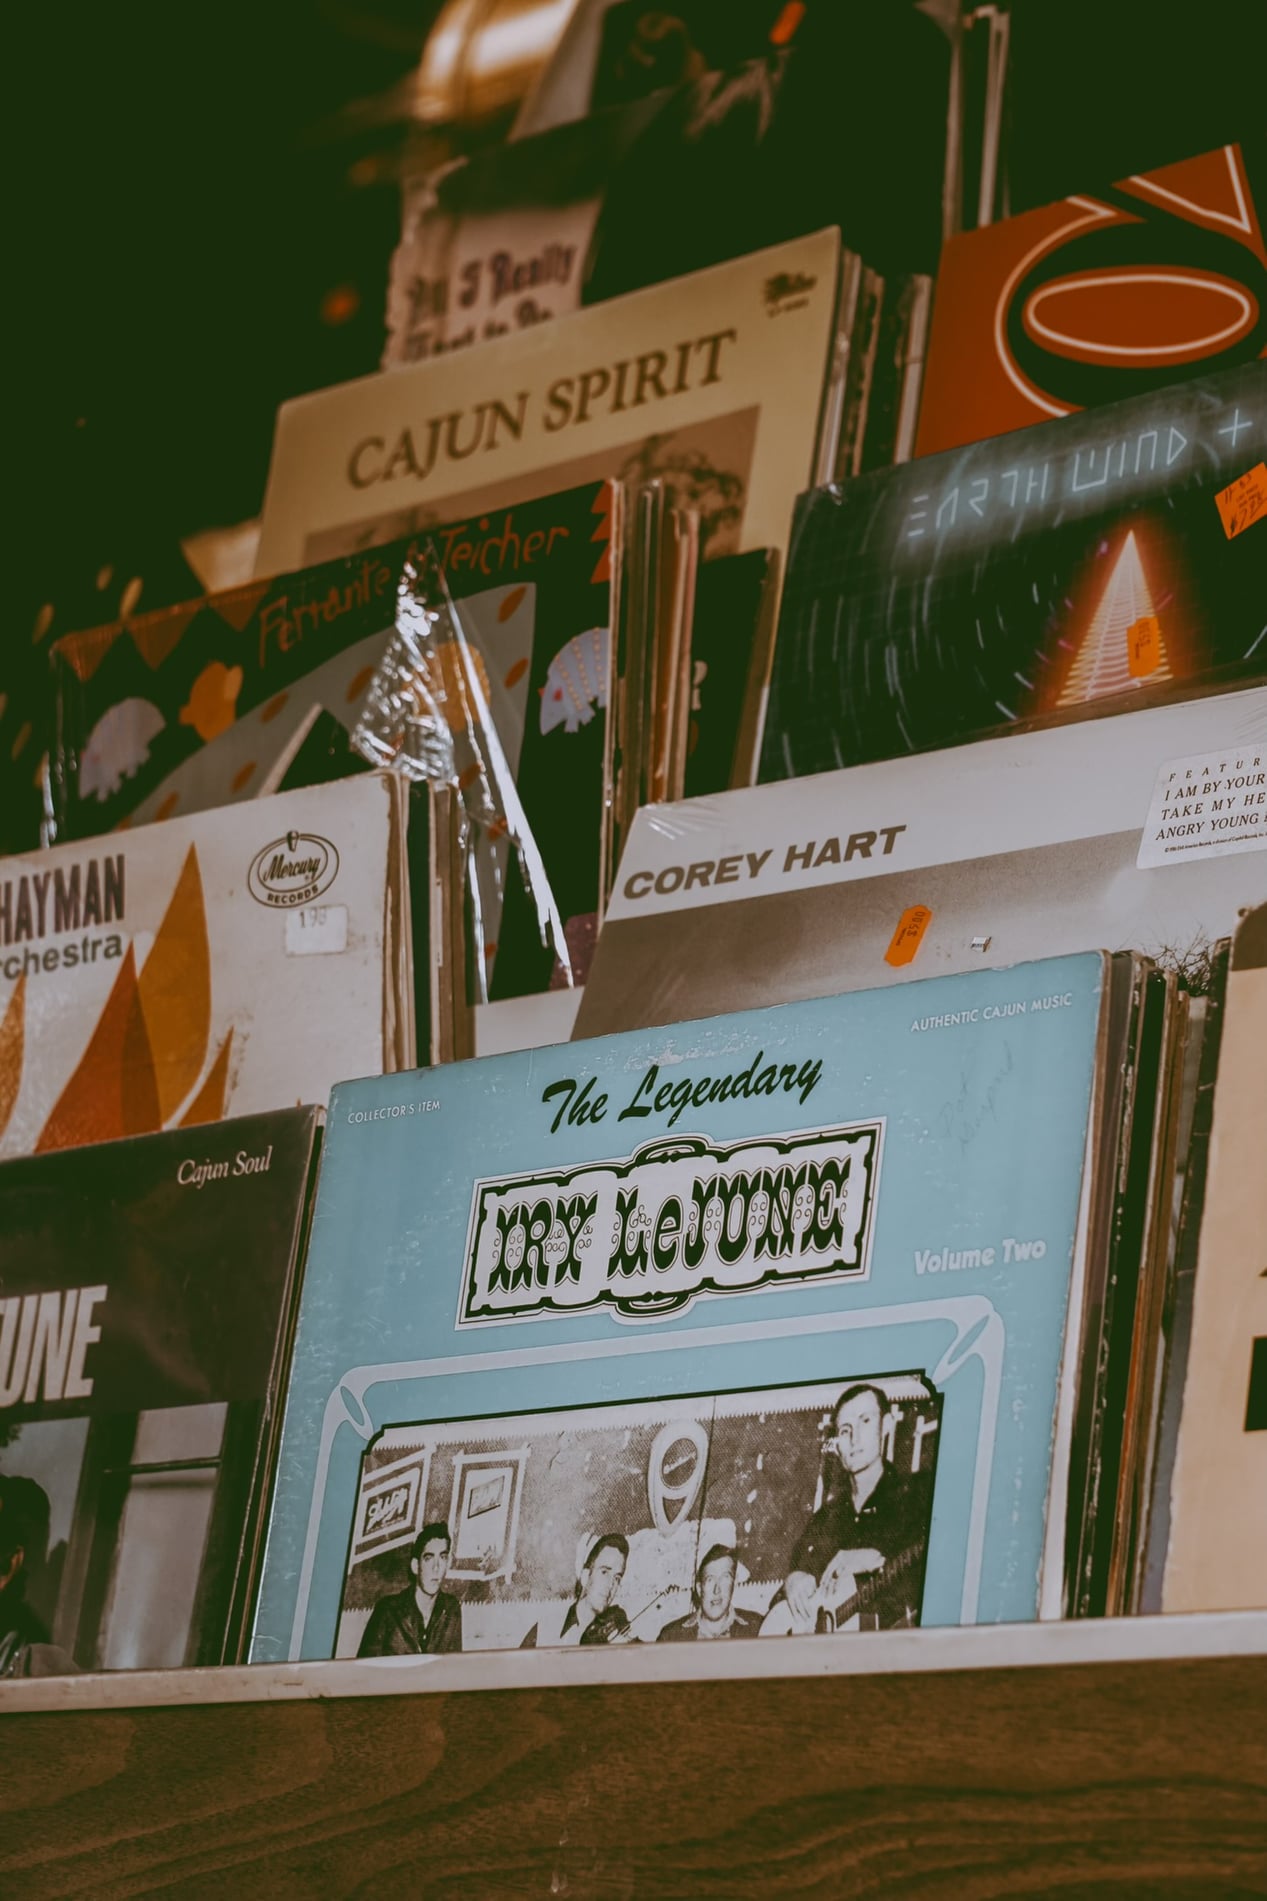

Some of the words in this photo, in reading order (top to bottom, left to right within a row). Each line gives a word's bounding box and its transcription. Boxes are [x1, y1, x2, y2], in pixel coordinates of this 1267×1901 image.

[347, 391, 530, 490] CAJUN
[542, 328, 738, 434] SPIRIT
[908, 462, 1049, 537] EARTH
[1072, 426, 1188, 493] WIND
[258, 560, 391, 669] Ferrante
[437, 513, 571, 576] Teicher
[1164, 789, 1171, 802] I
[1174, 785, 1198, 800] AM
[1202, 780, 1222, 795] BY
[1225, 773, 1266, 791] YOUR
[1168, 757, 1261, 782] FEATUR
[1155, 821, 1205, 841] ANGRY
[1211, 812, 1260, 832] YOUNG
[1161, 802, 1204, 821] TAKE
[1211, 797, 1236, 812] MY
[262, 853, 321, 882] Mercury
[623, 848, 774, 900] COREY
[782, 824, 908, 873] HART
[0, 853, 125, 947] HAYMAN
[267, 884, 319, 904] RECORDS
[0, 933, 123, 980] chestra
[910, 1008, 979, 1033] AUTHENTIC
[983, 1001, 1027, 1021] CAJUN
[1031, 992, 1073, 1012] MUSIC
[347, 1103, 415, 1124] COLLECTOR'S
[418, 1100, 441, 1113] ITEM
[541, 1075, 609, 1134] The
[617, 1050, 823, 1128] Legendary
[177, 1158, 229, 1189] Cajun
[232, 1145, 274, 1178] Soul
[486, 1190, 599, 1294] IRY
[914, 1246, 995, 1275] Volume
[1002, 1238, 1047, 1263] Two
[0, 1285, 108, 1408] UNE
